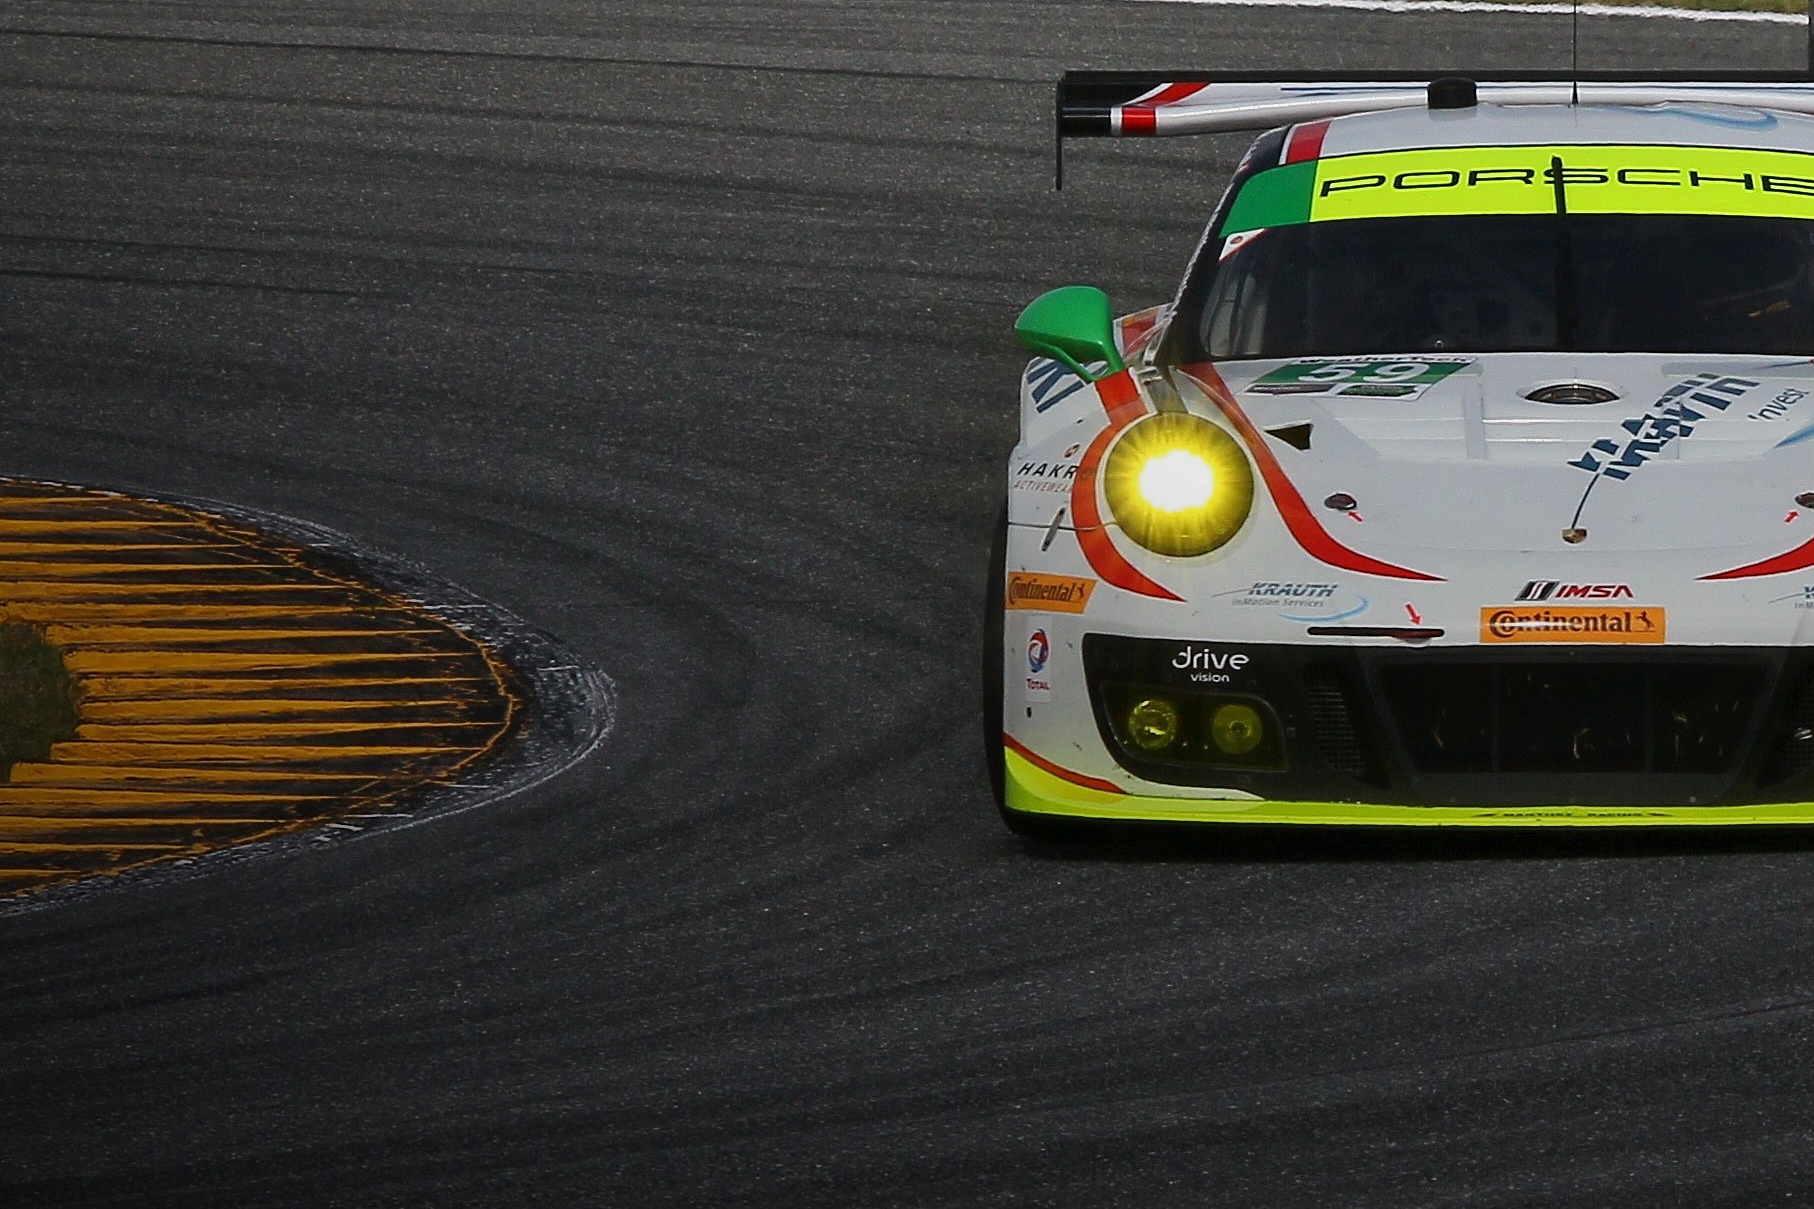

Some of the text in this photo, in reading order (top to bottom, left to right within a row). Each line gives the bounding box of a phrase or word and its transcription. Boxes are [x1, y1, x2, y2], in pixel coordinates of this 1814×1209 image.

[1298, 363, 1430, 382] 59
[1009, 576, 1076, 605] Continental
[1248, 582, 1338, 597] KRAUTH
[1555, 585, 1634, 598] IMSA
[1489, 610, 1633, 638] Continental
[1171, 645, 1250, 670] drive
[1190, 673, 1231, 683] vision
